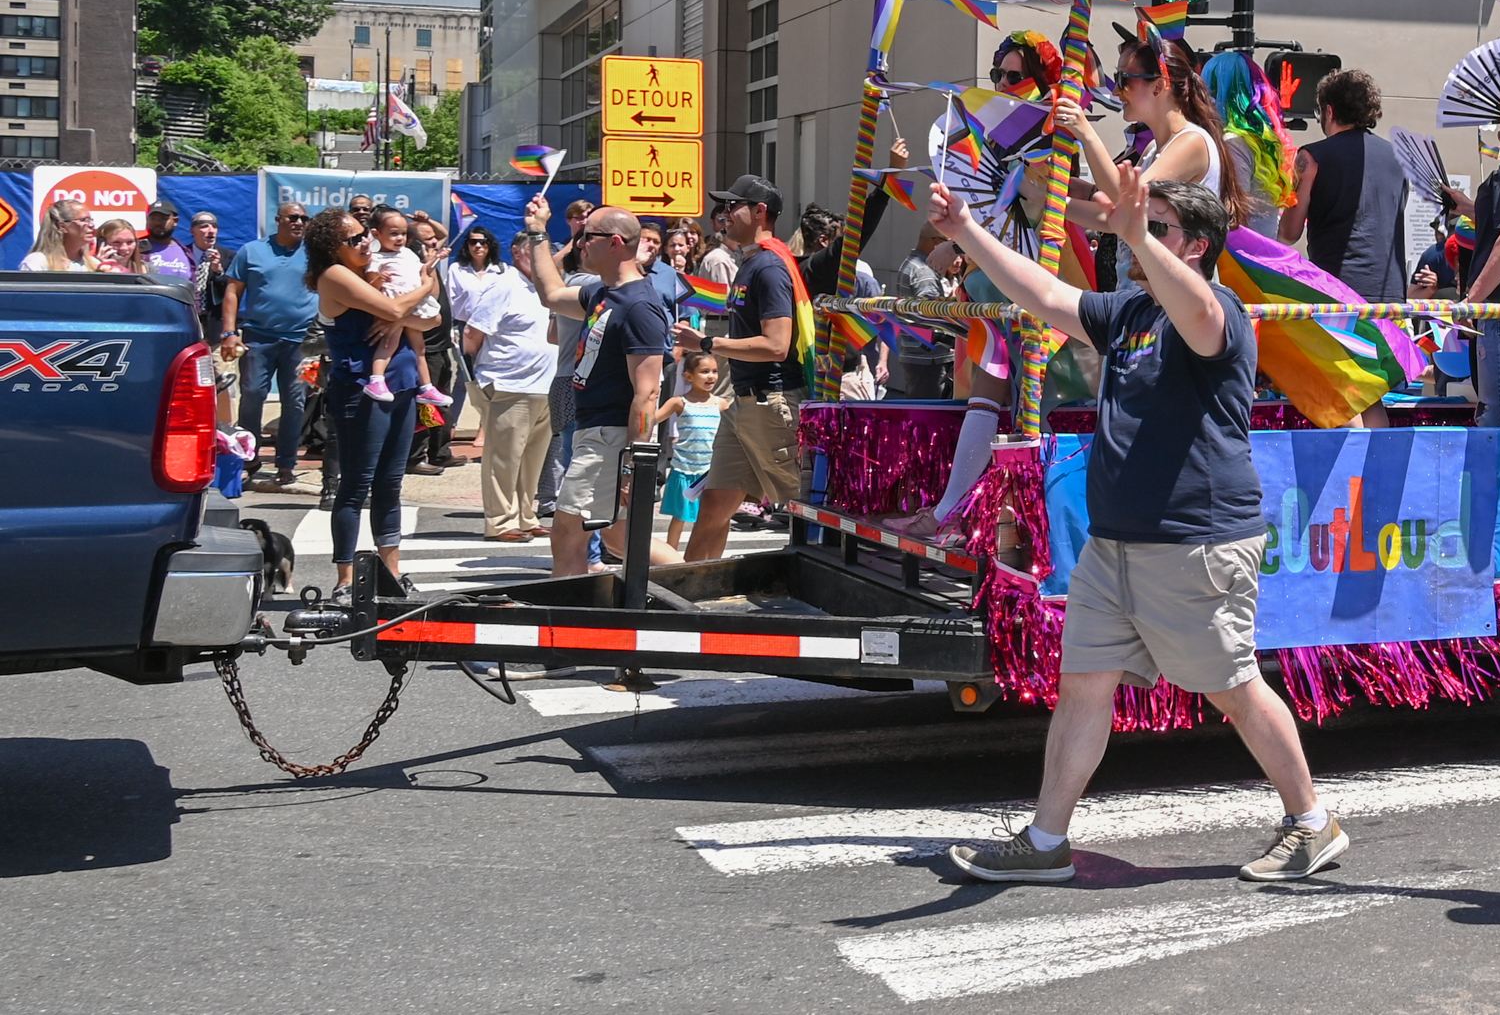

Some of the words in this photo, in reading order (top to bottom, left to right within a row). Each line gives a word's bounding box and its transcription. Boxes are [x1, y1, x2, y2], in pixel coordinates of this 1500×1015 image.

[612, 89, 693, 108] DETOUR
[612, 170, 693, 188] DETOUR
[54, 190, 86, 204] DO
[94, 190, 137, 206] NOT
[394, 194, 410, 209] a
[12, 383, 120, 393] ROAD
